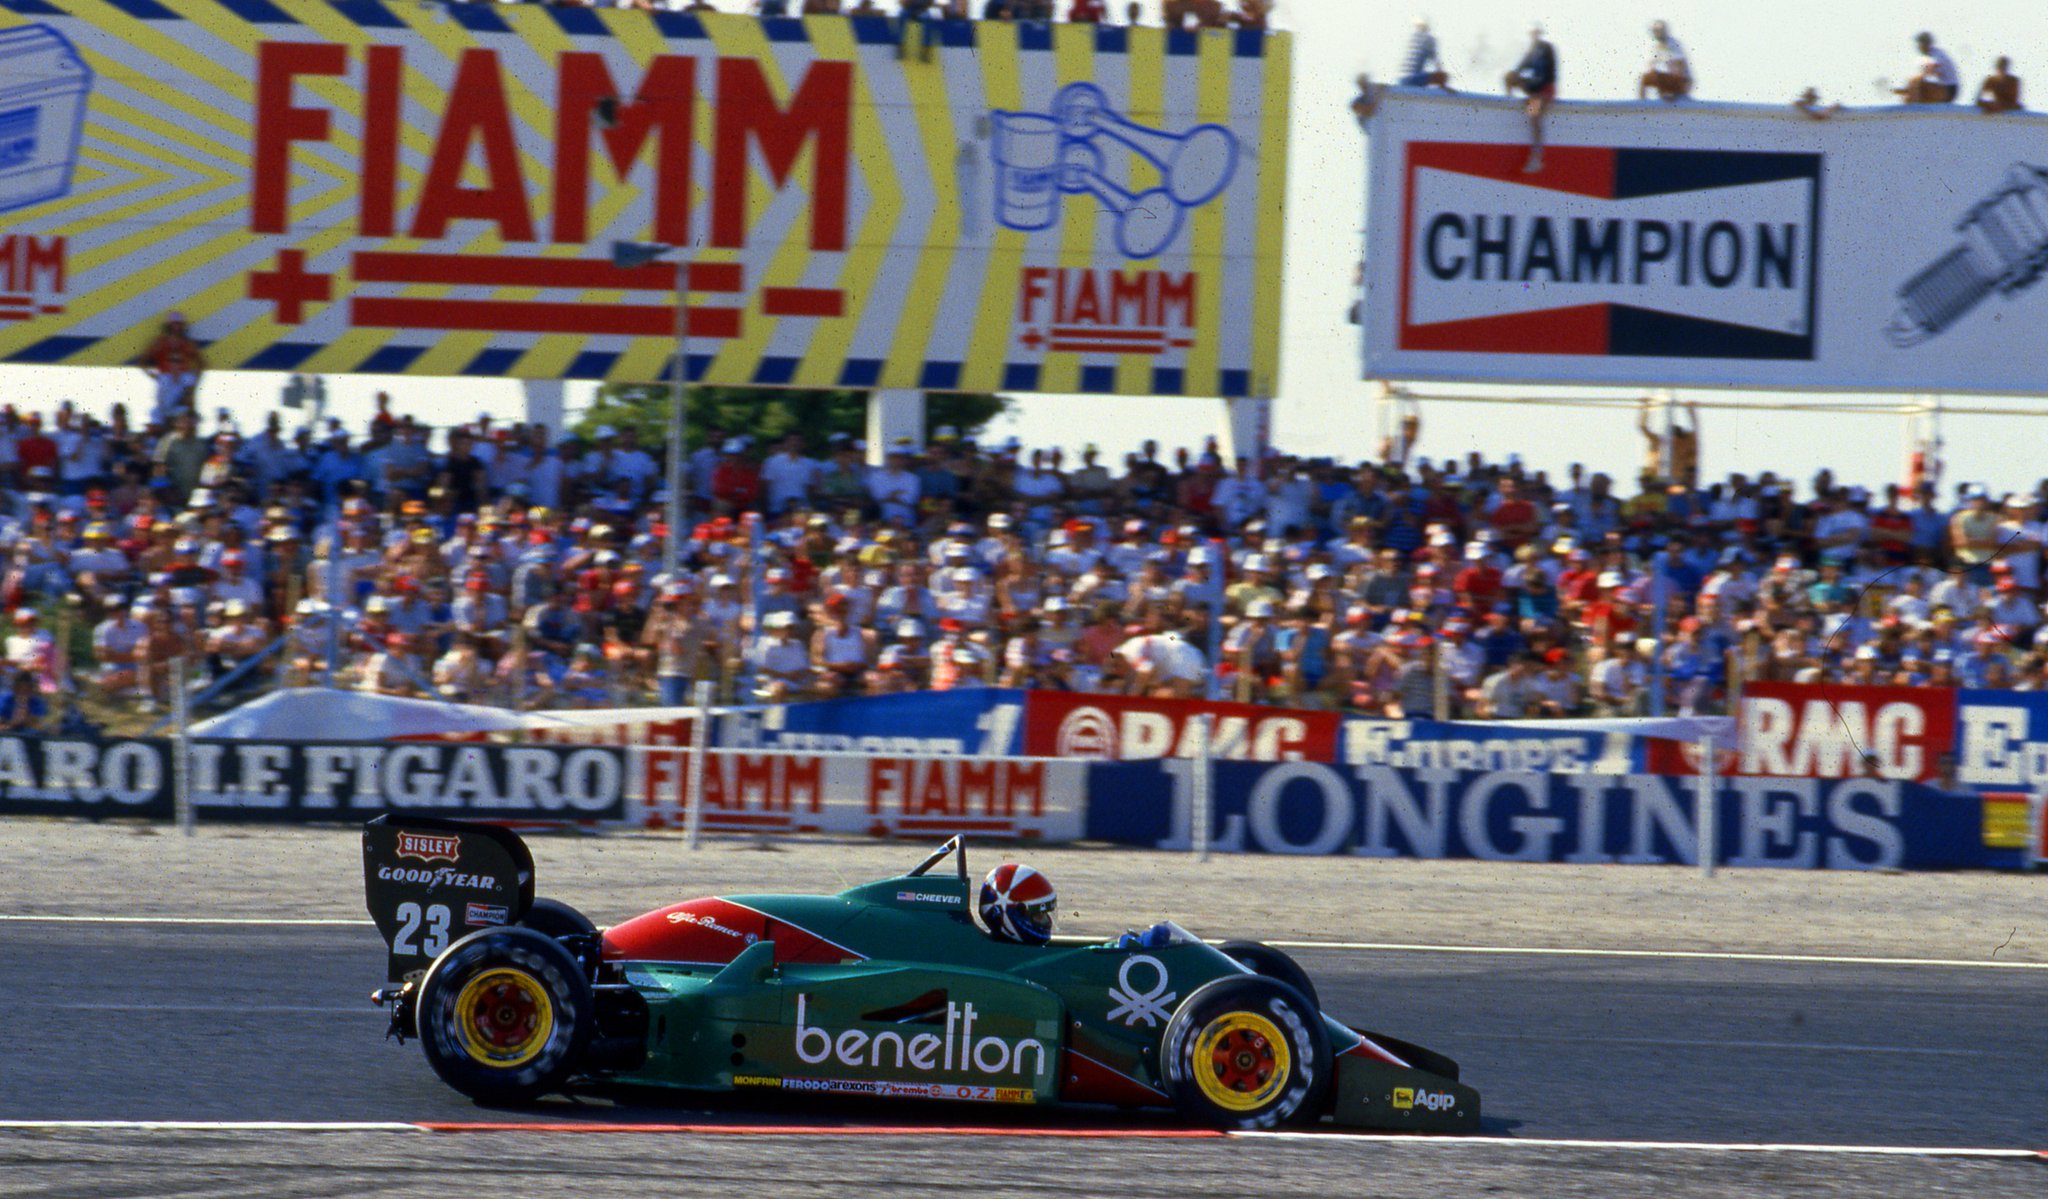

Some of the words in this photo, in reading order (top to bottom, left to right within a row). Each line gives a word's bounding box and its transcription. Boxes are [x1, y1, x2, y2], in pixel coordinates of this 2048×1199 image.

[250, 40, 855, 252] FIAMM
[1424, 211, 1800, 290] CHAMPION
[1018, 266, 1199, 329] FIAMM
[1739, 697, 1926, 781] RMC
[189, 743, 290, 807] LE
[304, 744, 622, 811] FIGARO
[644, 750, 823, 813] FIAMM
[867, 757, 1043, 817] FIAMM
[1156, 756, 1904, 871] LONGINES
[404, 837, 453, 854] SISLEY
[469, 910, 504, 921] CHAMPION
[916, 893, 961, 904] CHEEVER
[393, 902, 451, 958] 23
[795, 993, 1045, 1075] benetton
[782, 1078, 829, 1090] FERODO
[829, 1079, 877, 1092] arexons
[1414, 1088, 1455, 1111] Agip
